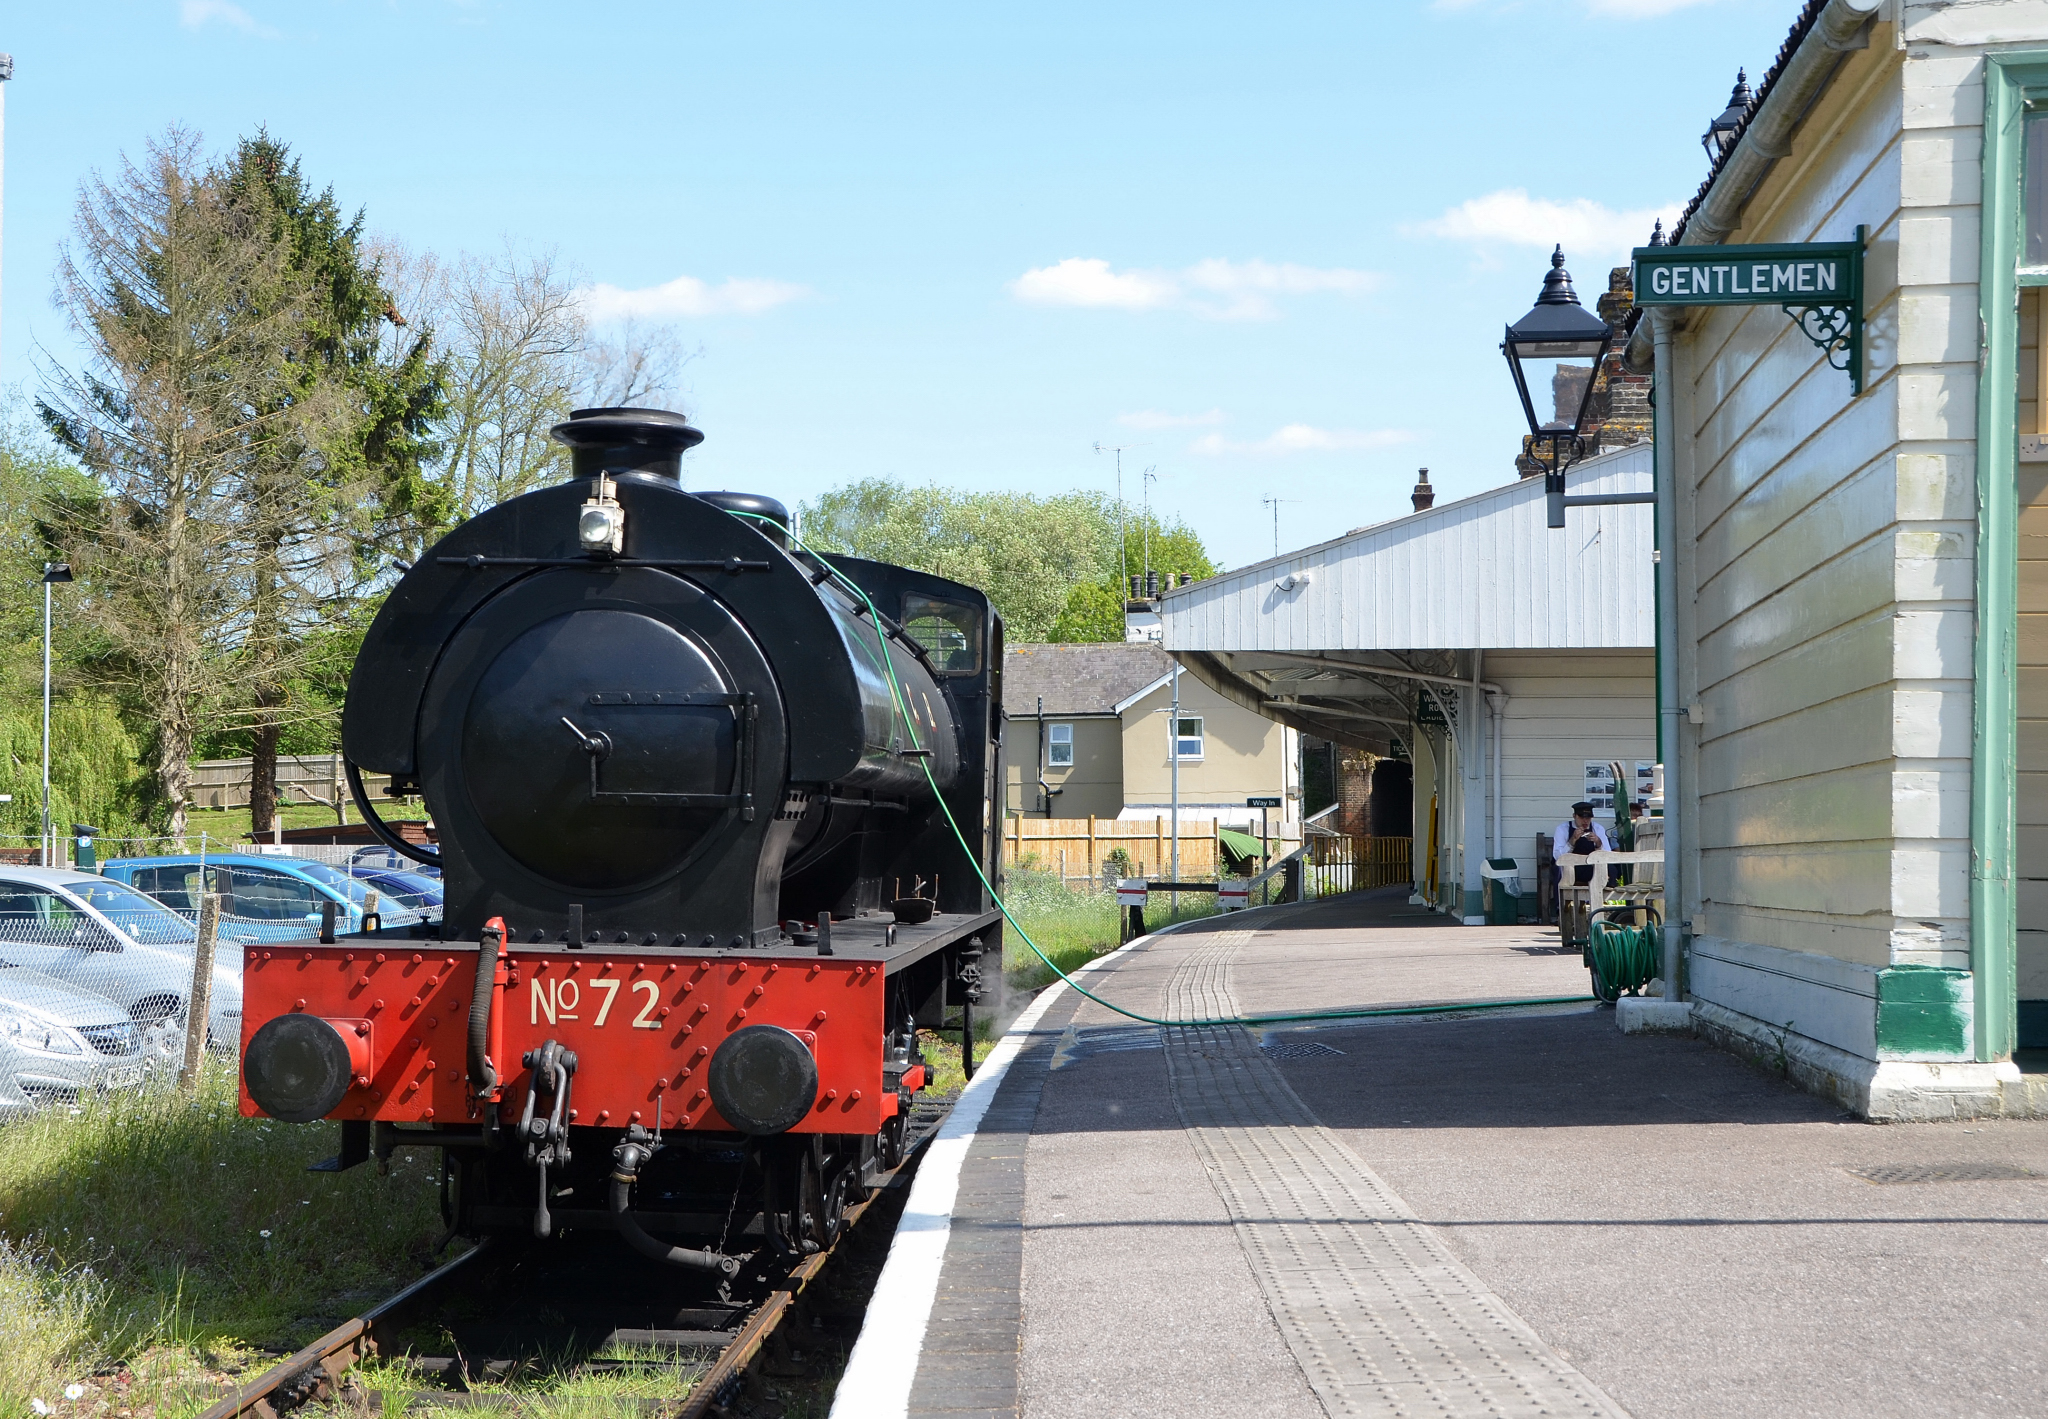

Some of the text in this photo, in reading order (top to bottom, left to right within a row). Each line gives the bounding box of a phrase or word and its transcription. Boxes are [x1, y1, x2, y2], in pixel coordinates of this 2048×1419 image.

[1652, 262, 1836, 295] GENTLEMEN
[1252, 799, 1268, 807] Way
[589, 979, 662, 1029] 72
